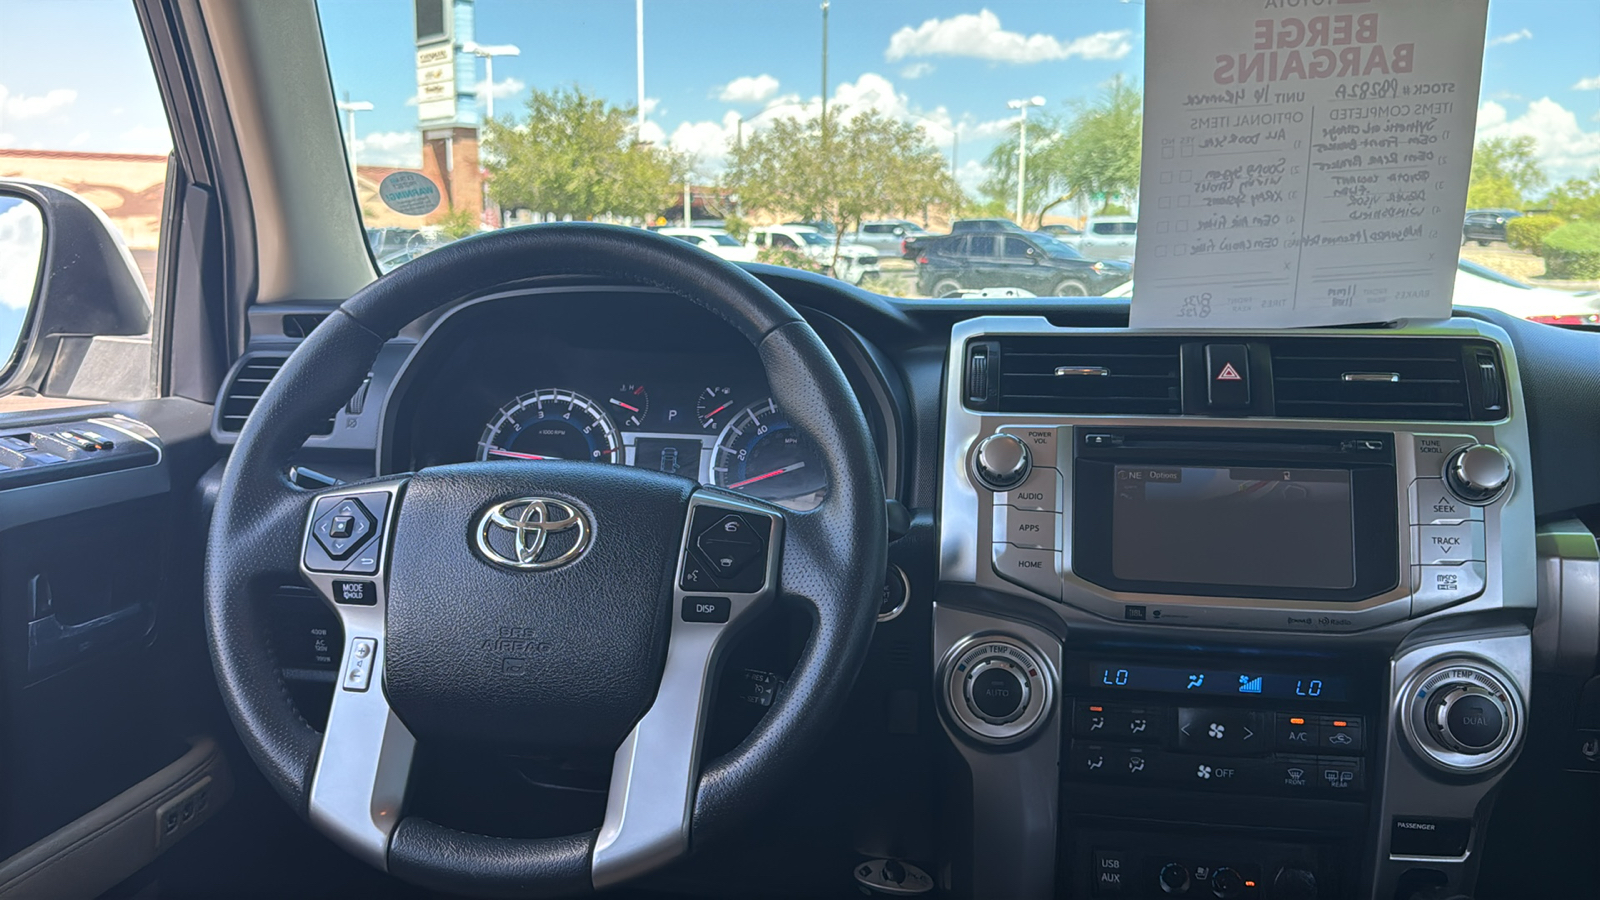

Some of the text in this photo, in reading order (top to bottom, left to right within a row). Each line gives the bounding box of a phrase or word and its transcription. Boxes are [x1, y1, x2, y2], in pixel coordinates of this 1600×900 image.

[537, 411, 544, 419] 3
[562, 412, 570, 420] 4
[668, 410, 678, 421] P
[513, 423, 522, 432] 2
[583, 427, 592, 435] 5
[756, 425, 768, 436] 40
[592, 449, 601, 458] 6
[737, 448, 748, 462] 20
[1128, 470, 1178, 481] NE Options
[1017, 492, 1044, 501] AUDIO
[1433, 505, 1456, 513] SEEK
[1018, 523, 1040, 532] APPS
[1431, 536, 1461, 546] TRACK
[1018, 560, 1043, 569] HOME
[342, 583, 364, 592] MODE
[696, 604, 715, 614] DISP
[988, 645, 1009, 654] TEMP
[1103, 669, 1129, 686] LO
[1451, 670, 1473, 679] TEMP
[986, 688, 1009, 697] AUTO
[1295, 680, 1323, 697] LO
[1462, 716, 1488, 726] DUAL
[1288, 732, 1308, 741] A/C
[1214, 769, 1235, 778] OFF
[1284, 778, 1306, 786] FRONT
[1397, 821, 1436, 831] PASSENGER
[1101, 859, 1120, 869] USB
[1101, 873, 1120, 883] AUX
